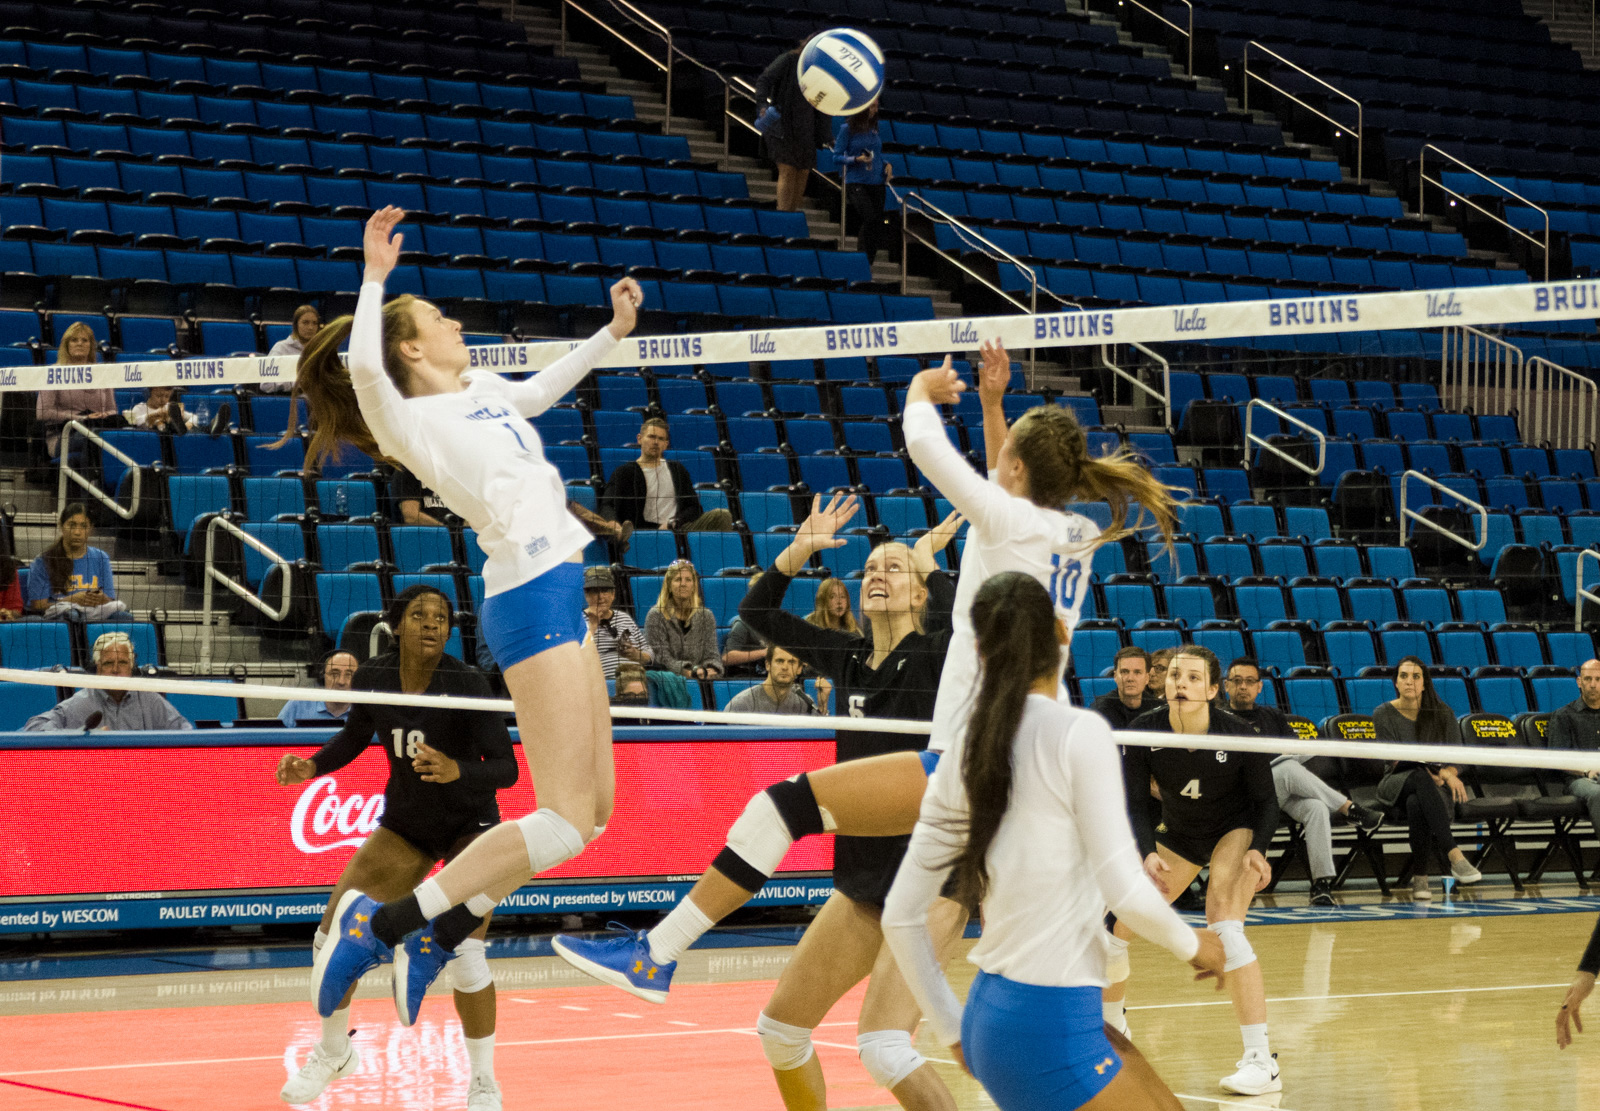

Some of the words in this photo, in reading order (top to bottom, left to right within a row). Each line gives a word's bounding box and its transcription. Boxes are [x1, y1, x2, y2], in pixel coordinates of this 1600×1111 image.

[47, 367, 93, 384] BRUINS
[124, 364, 142, 382] Ucla
[176, 361, 224, 379] BRUINS
[258, 358, 279, 377] Ucla
[470, 346, 527, 367] BRUINS
[638, 337, 702, 359] BRUINS
[748, 333, 776, 354] Ucla
[825, 326, 898, 350] BRUINS
[948, 321, 979, 344] Ucla
[1034, 314, 1114, 339] BRUINS
[1173, 308, 1207, 332] Ucla
[1268, 299, 1359, 326] BRUINS
[1424, 292, 1462, 318] Ucla
[1534, 284, 1600, 311] BRUI
[1049, 553, 1082, 610] 10
[391, 728, 425, 759] 18
[1180, 779, 1202, 799] 4
[290, 776, 387, 853] Coca
[105, 892, 162, 900] DAKTRONICS
[499, 894, 549, 907] AVILION
[553, 892, 608, 908] presented
[611, 891, 625, 906] by
[627, 890, 675, 903] WESCOM
[0, 911, 39, 925] ented
[42, 911, 59, 928] by
[62, 908, 119, 923] WESCOM
[159, 906, 207, 919] PAULEY
[211, 904, 272, 918] PAVILION
[275, 903, 328, 919] presente
